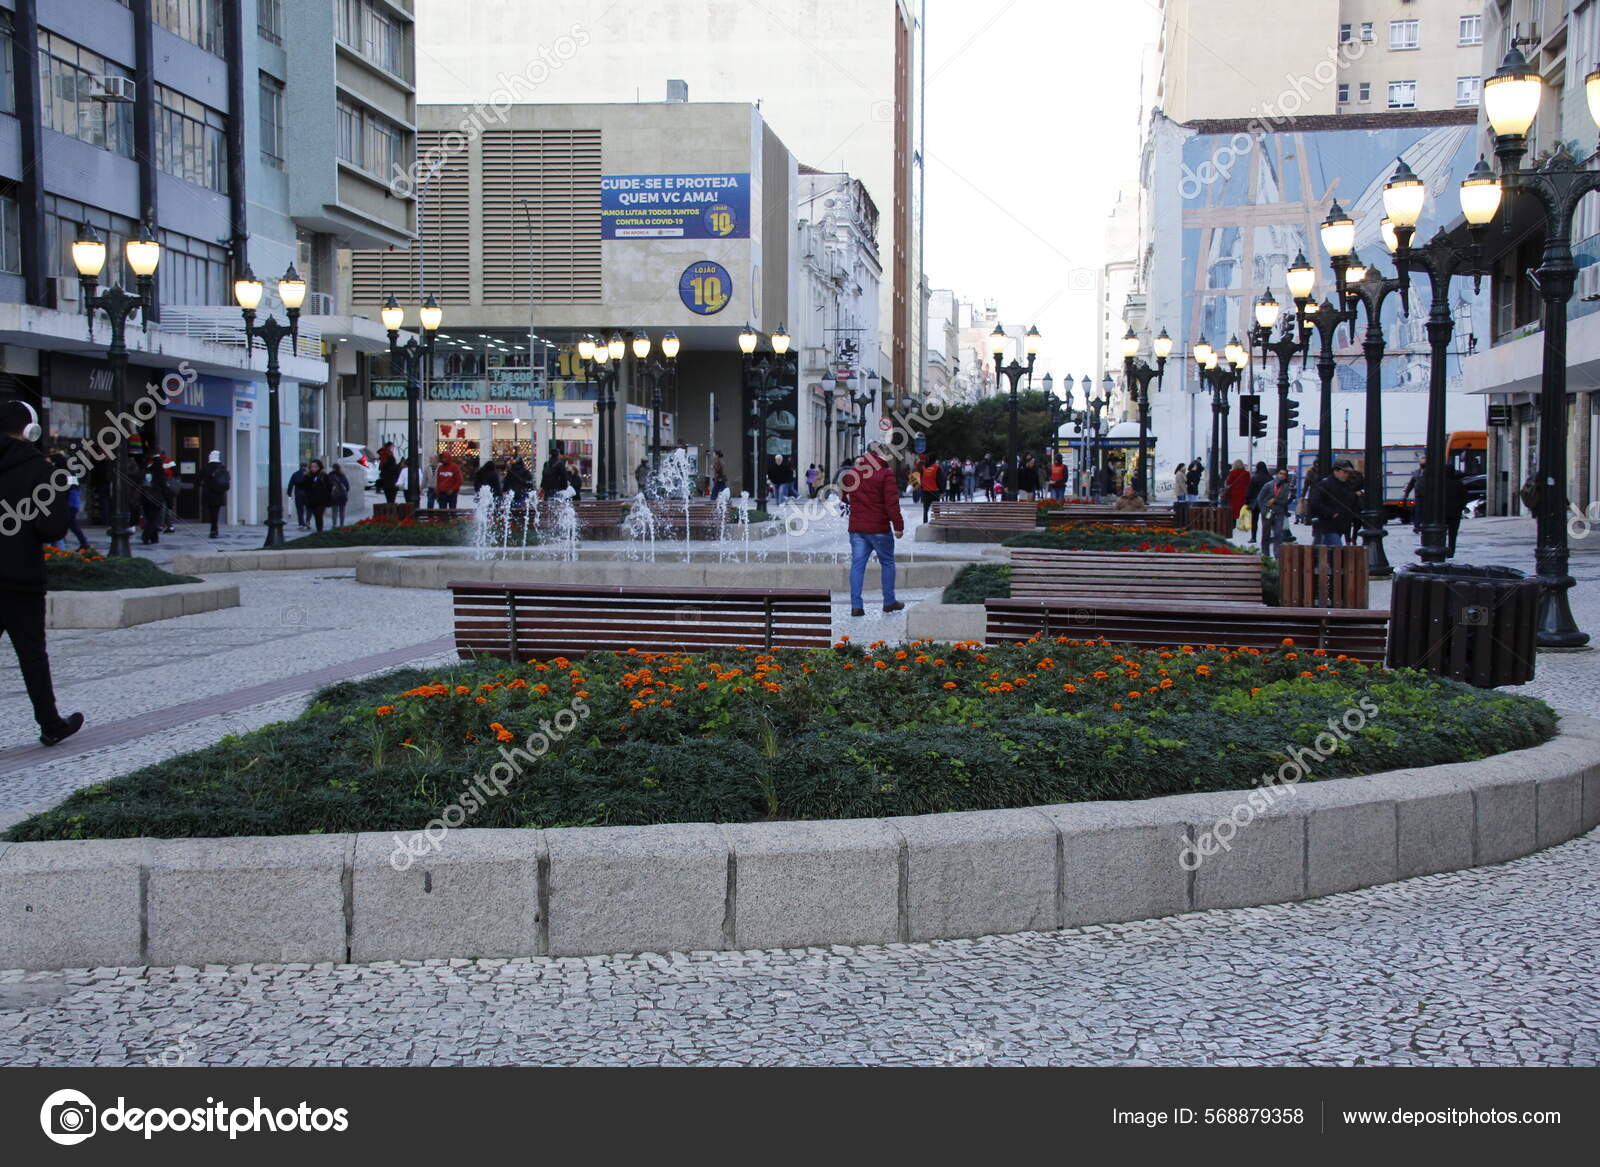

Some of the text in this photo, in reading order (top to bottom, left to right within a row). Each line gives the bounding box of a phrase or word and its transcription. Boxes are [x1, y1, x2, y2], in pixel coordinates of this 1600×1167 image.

[600, 176, 738, 190] CUIDE-SE E PROTEJA
[619, 191, 718, 205] QUEM VC AMA!
[673, 208, 700, 216] JUNTOS
[616, 218, 684, 226] CONTRA O COVID-19
[694, 265, 716, 274] LOJÃO
[374, 384, 407, 398] ROUP
[460, 404, 513, 416] Via Pink
